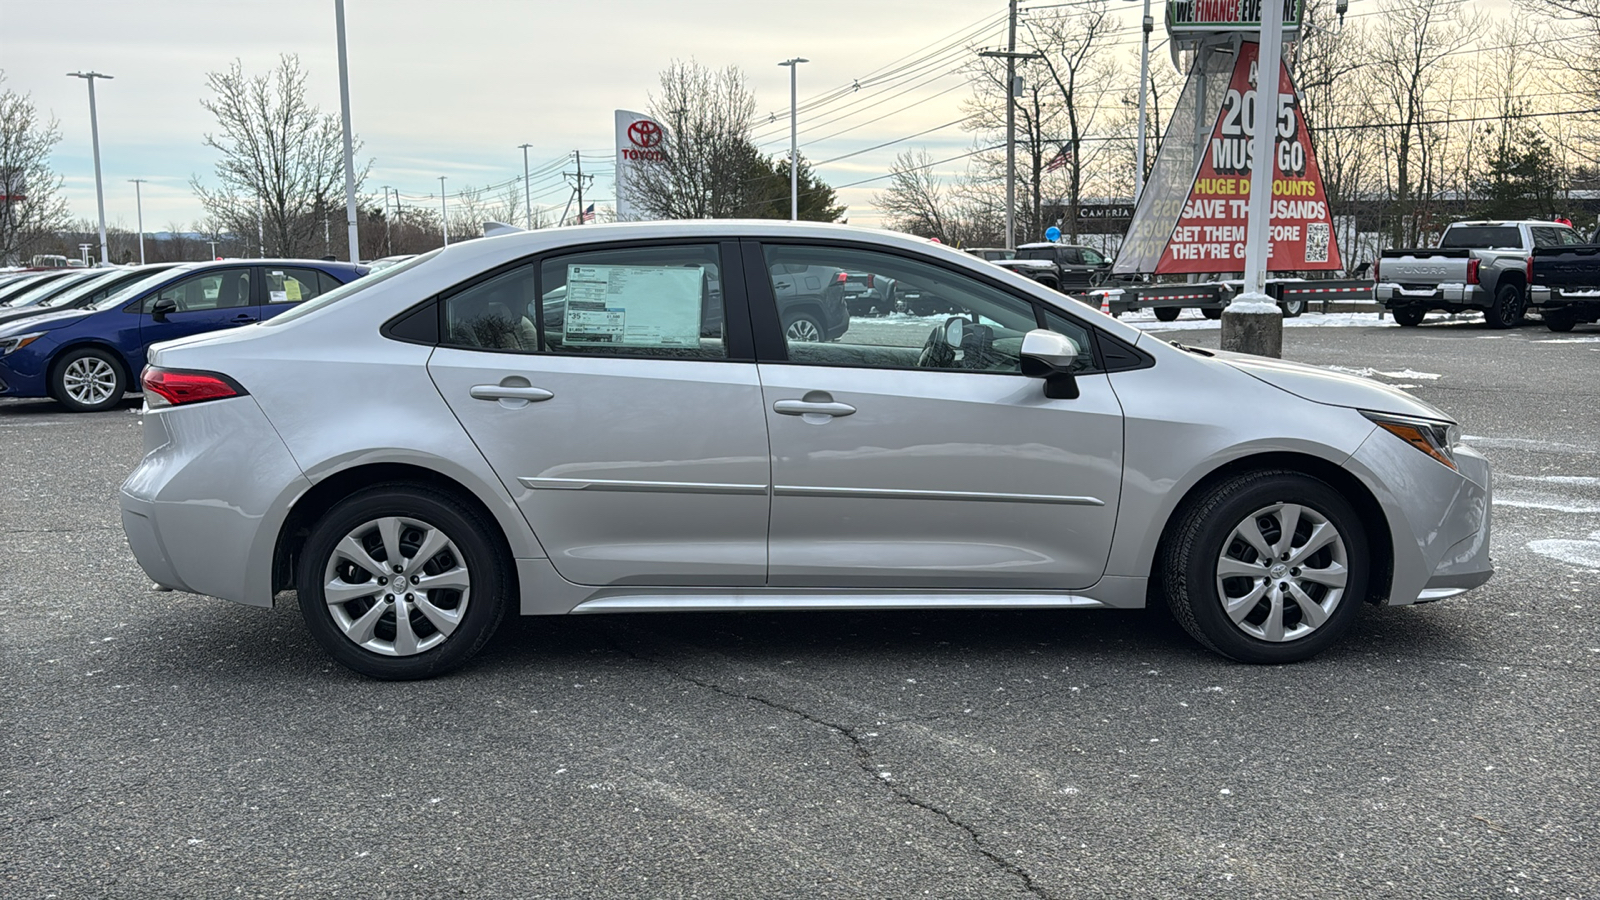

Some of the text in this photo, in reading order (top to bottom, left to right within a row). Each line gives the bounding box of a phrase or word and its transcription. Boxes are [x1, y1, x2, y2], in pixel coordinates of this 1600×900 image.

[1176, 0, 1297, 22] WE FINANCE EVENE
[1222, 89, 1296, 139] 205
[1212, 138, 1304, 172] MUS GO
[1194, 178, 1316, 197] HUGE DOUNTS
[1182, 199, 1326, 220] SAVE THUSANDS
[1172, 225, 1301, 242] GET THEM FORE
[1170, 243, 1274, 260] THEY'RE GE
[1396, 266, 1447, 275] TUNDRA
